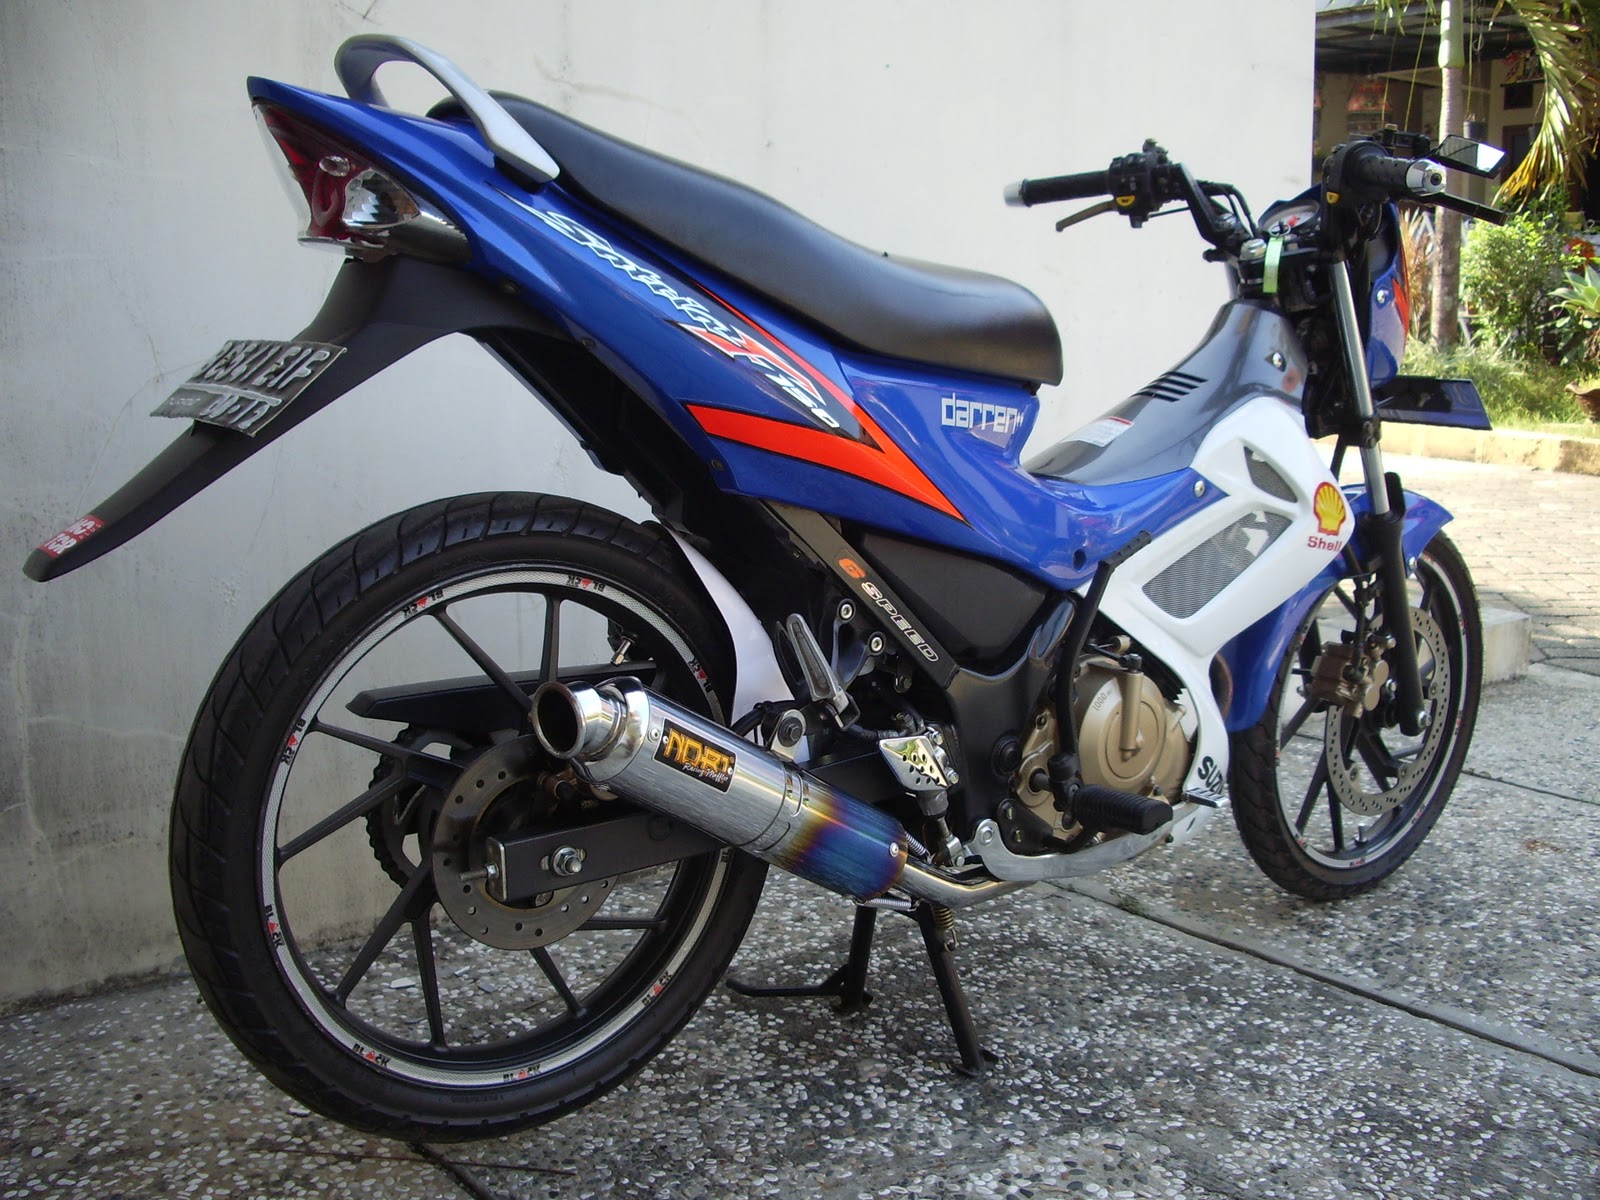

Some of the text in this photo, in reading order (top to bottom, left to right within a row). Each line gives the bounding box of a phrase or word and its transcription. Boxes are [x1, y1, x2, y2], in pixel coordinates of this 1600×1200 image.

[764, 372, 841, 429] 150
[941, 392, 1018, 434] darren
[1307, 535, 1342, 552] Shell
[861, 581, 939, 662] SPEED
